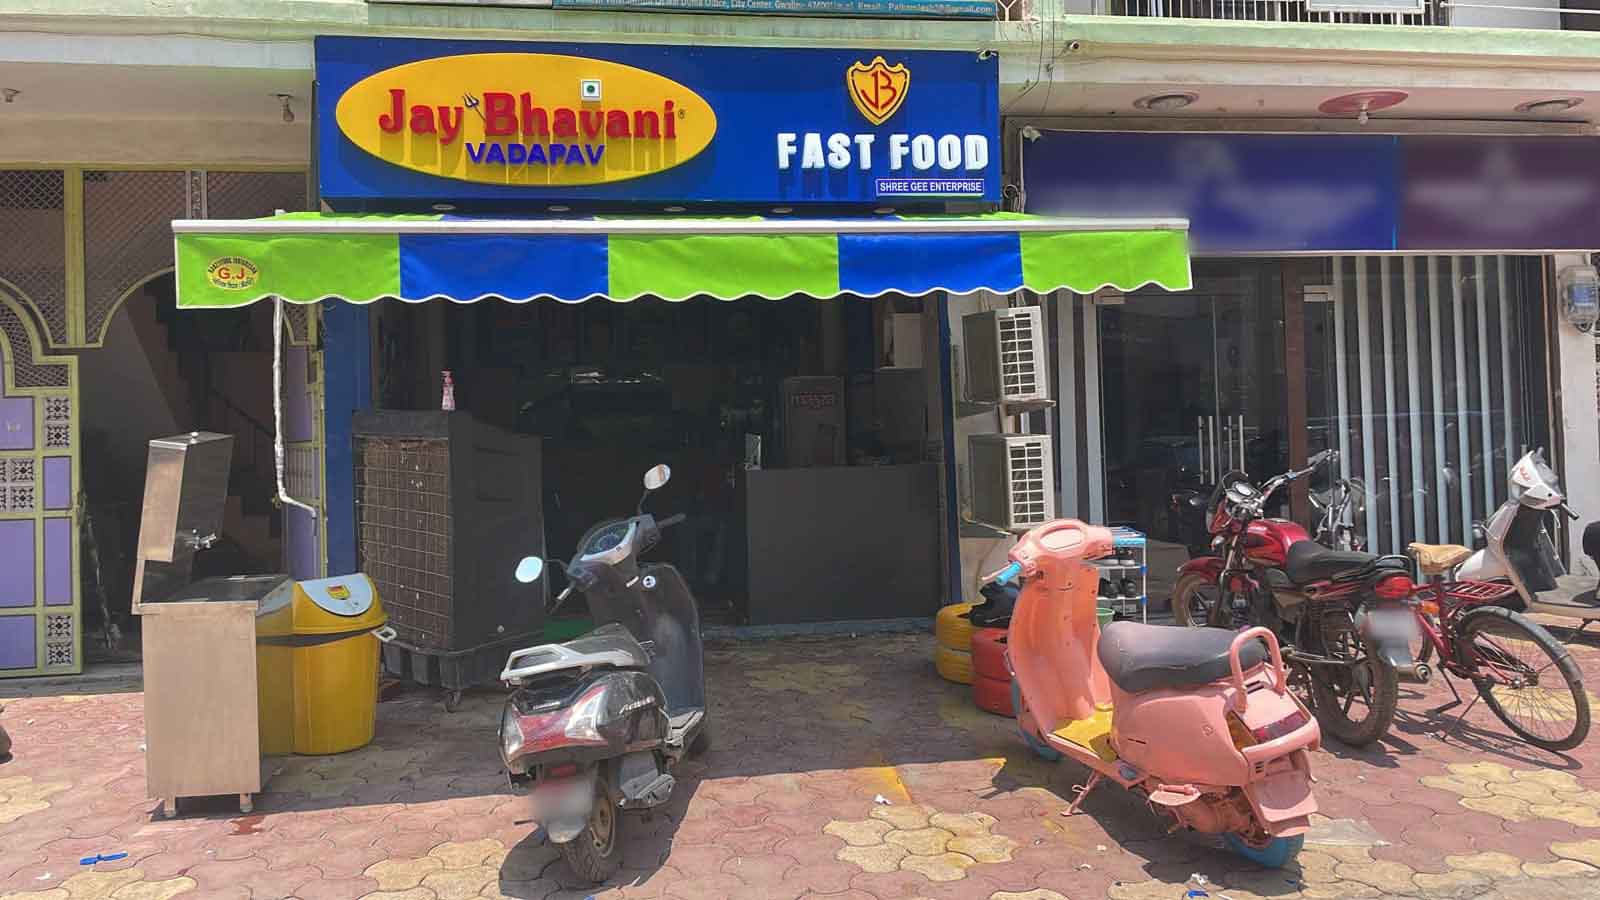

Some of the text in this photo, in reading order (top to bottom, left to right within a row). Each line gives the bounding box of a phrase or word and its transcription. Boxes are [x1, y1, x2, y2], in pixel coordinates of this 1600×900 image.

[379, 89, 677, 144] Jay Bhavani
[465, 143, 605, 167] VADAPAV
[777, 133, 989, 170] FAST FOOD
[879, 181, 982, 193] SHREE GEE ENTERPRISE
